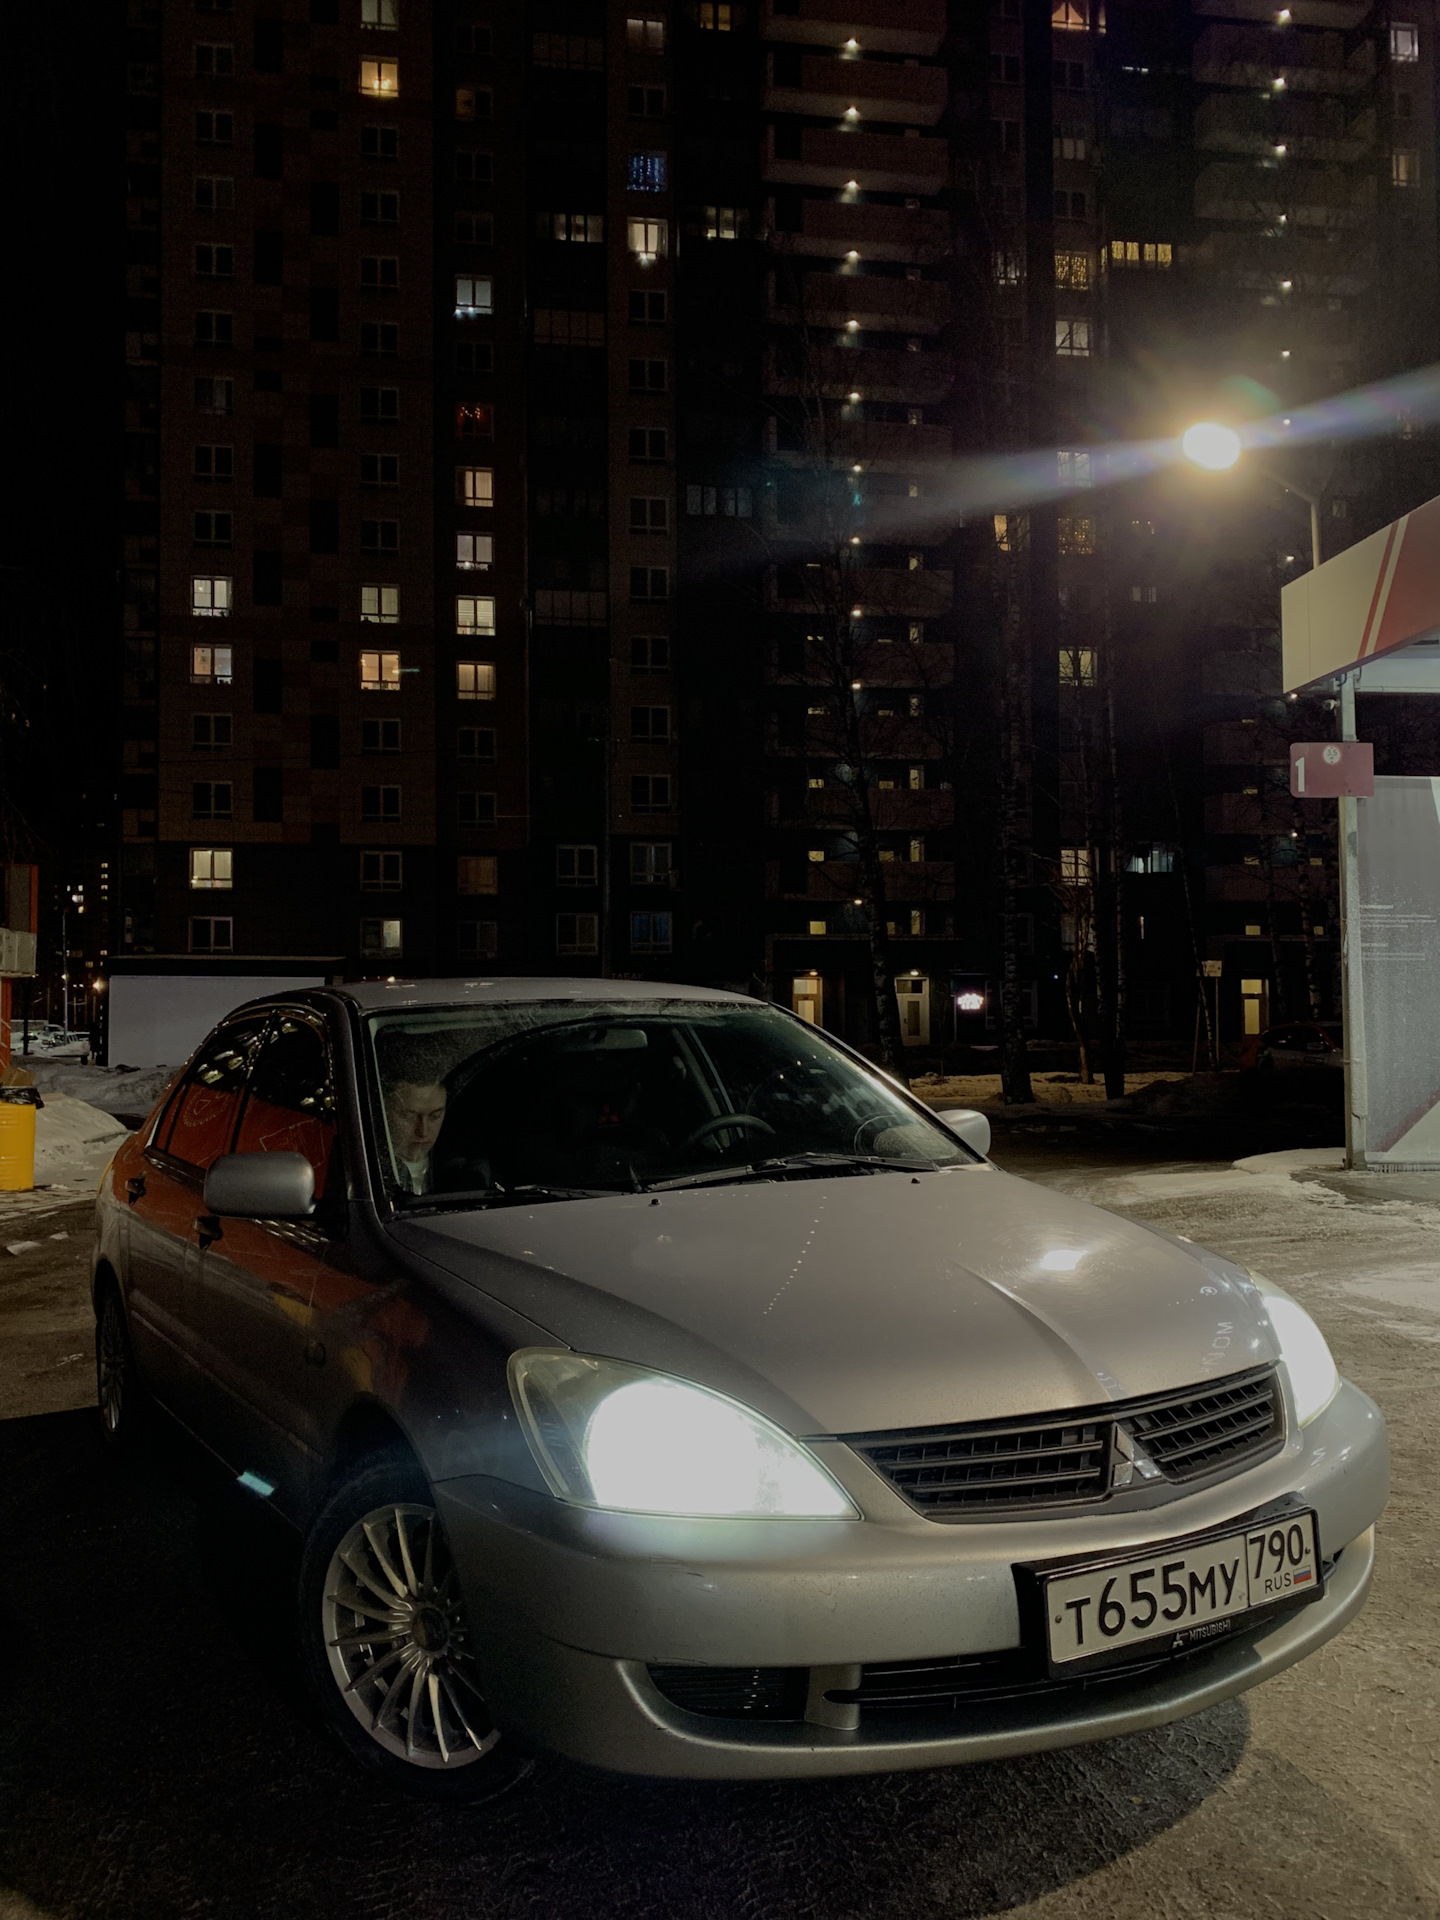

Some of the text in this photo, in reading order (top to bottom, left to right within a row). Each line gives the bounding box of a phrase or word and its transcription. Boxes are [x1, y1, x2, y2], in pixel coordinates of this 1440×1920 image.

[1295, 757, 1305, 792] 1
[1249, 1523, 1304, 1579] 790
[1265, 1573, 1292, 1594] RUS
[1189, 1619, 1231, 1640] MITSUBISHI
